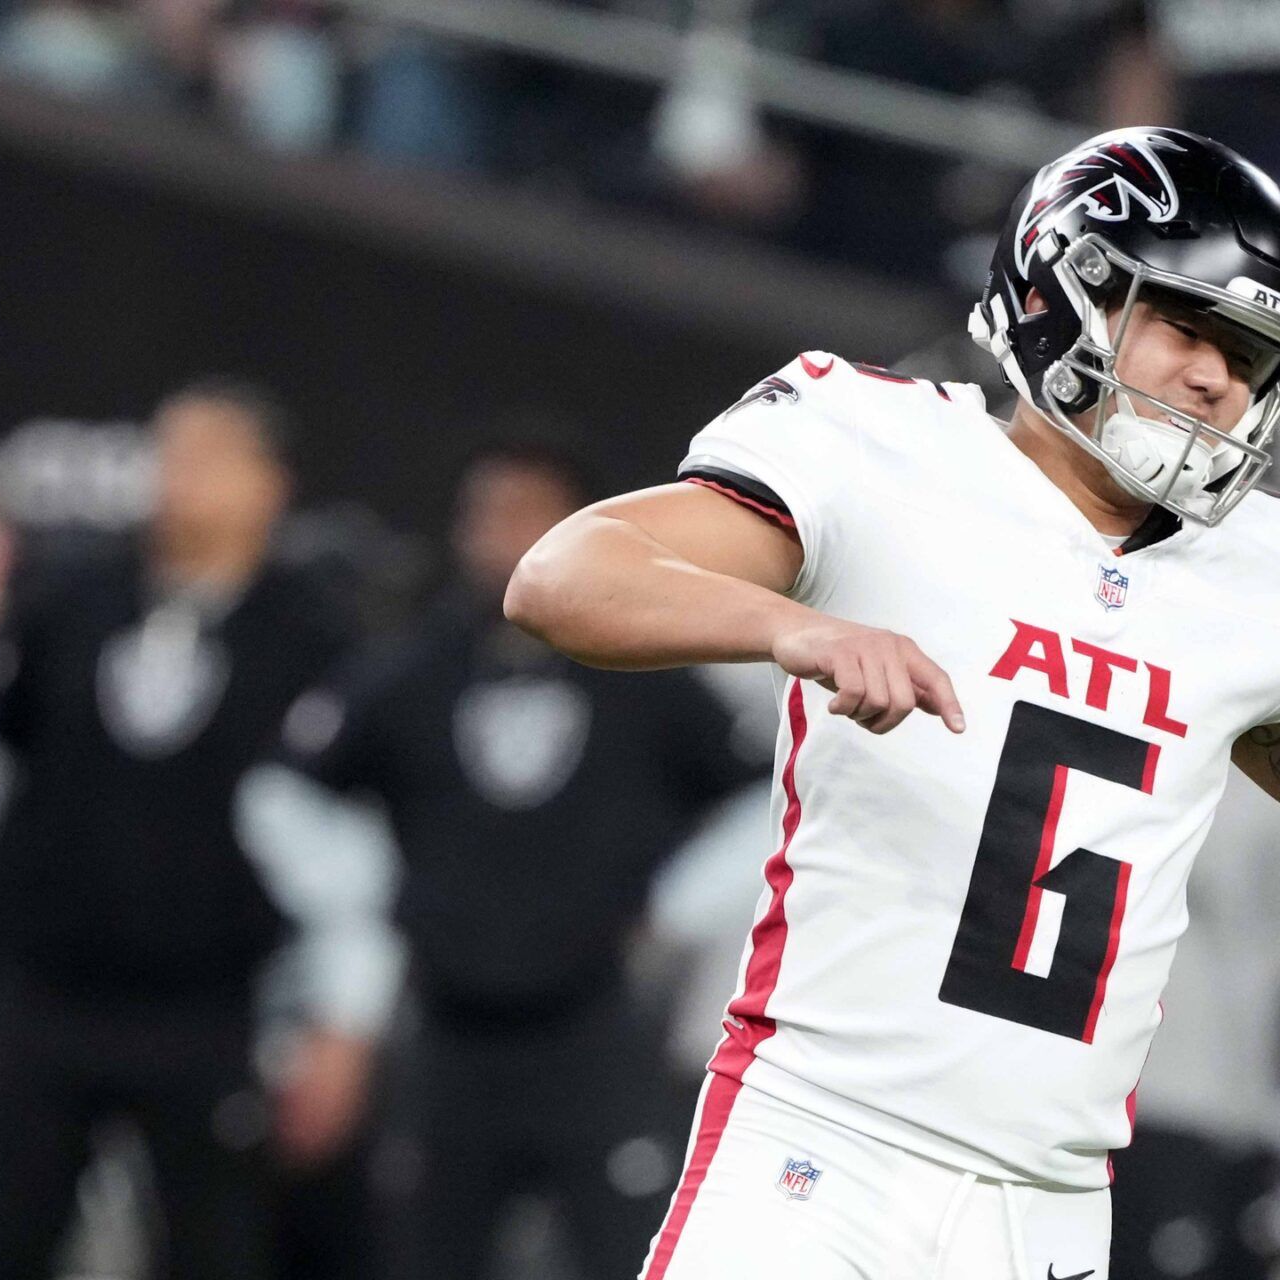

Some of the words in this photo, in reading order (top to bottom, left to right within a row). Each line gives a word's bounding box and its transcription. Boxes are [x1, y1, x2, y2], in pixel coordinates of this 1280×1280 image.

[1100, 582, 1123, 604] NFL
[988, 618, 1188, 738] ATL
[938, 699, 1162, 1045] 6
[781, 1170, 809, 1193] NFL
